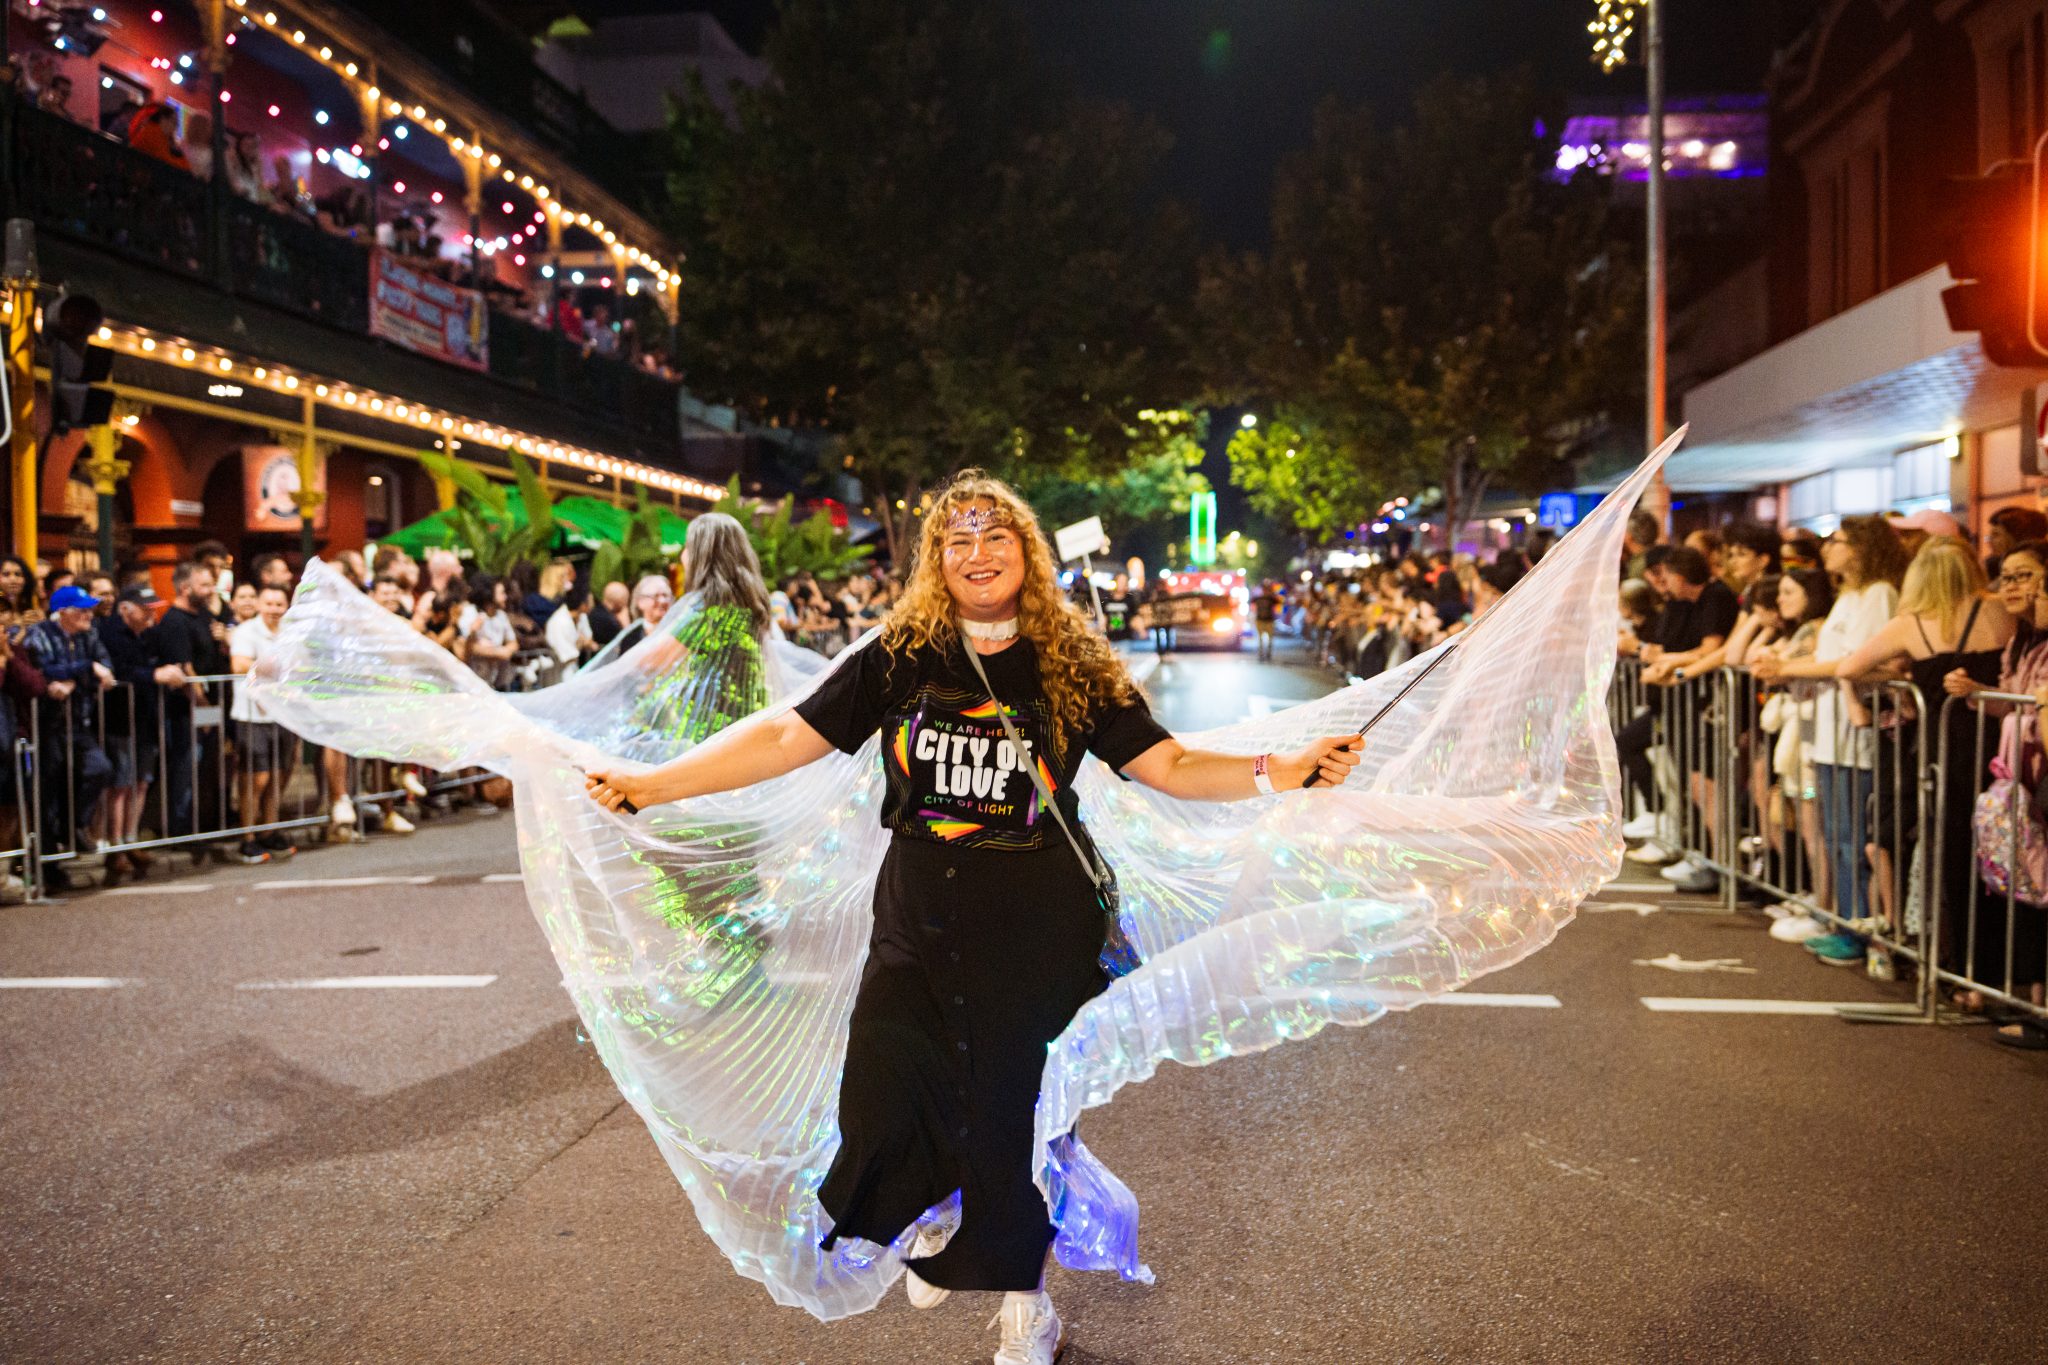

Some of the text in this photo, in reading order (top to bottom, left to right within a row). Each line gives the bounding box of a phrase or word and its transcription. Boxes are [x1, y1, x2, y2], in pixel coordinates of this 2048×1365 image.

[934, 720, 952, 731] WE
[956, 724, 981, 736] ARE
[915, 728, 1033, 772] CITY OF
[935, 762, 1010, 801] LOVE
[924, 796, 1014, 815] CITY OF LIGHT
